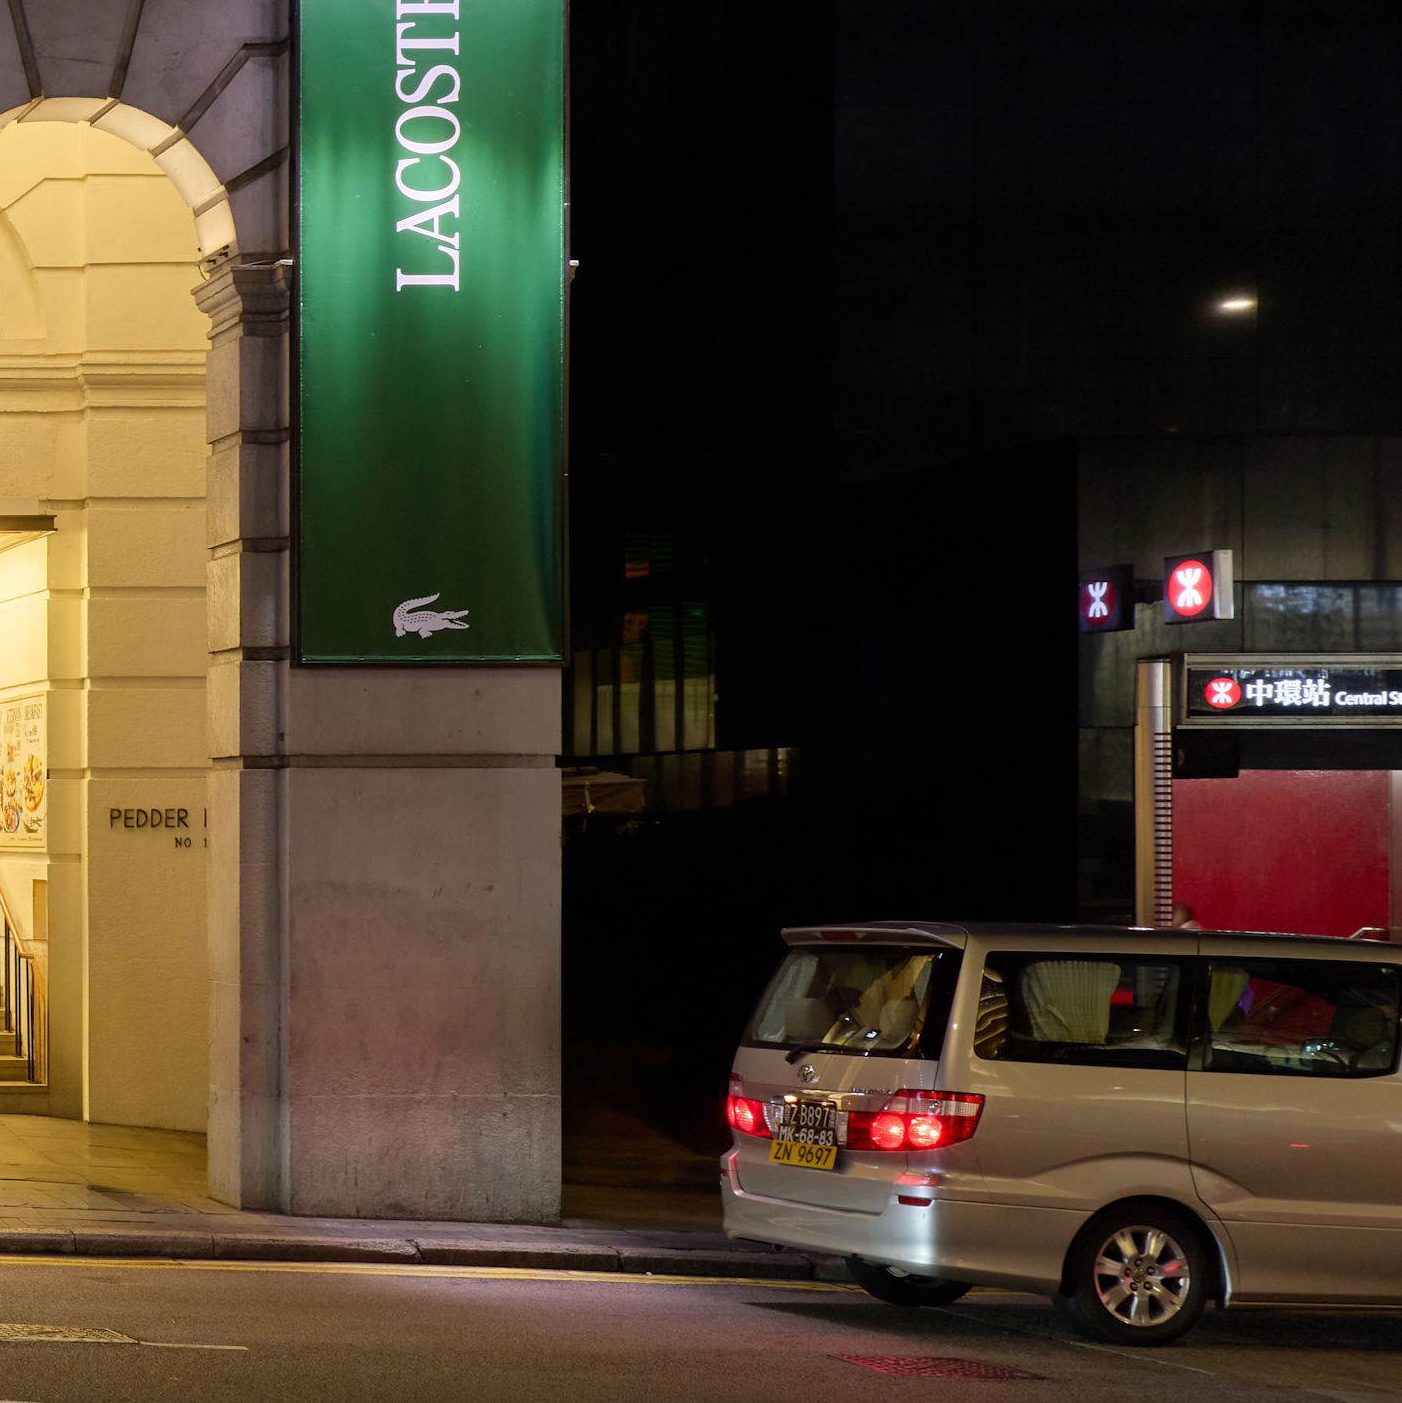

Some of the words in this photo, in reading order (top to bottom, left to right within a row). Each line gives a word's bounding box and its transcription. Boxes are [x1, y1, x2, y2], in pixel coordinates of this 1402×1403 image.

[1245, 678, 1331, 707] 中環站
[1335, 690, 1388, 706] Central
[109, 807, 189, 829] PEDDER
[174, 837, 192, 848] NO
[773, 1142, 793, 1161] ZN
[798, 1145, 832, 1166] 9697
